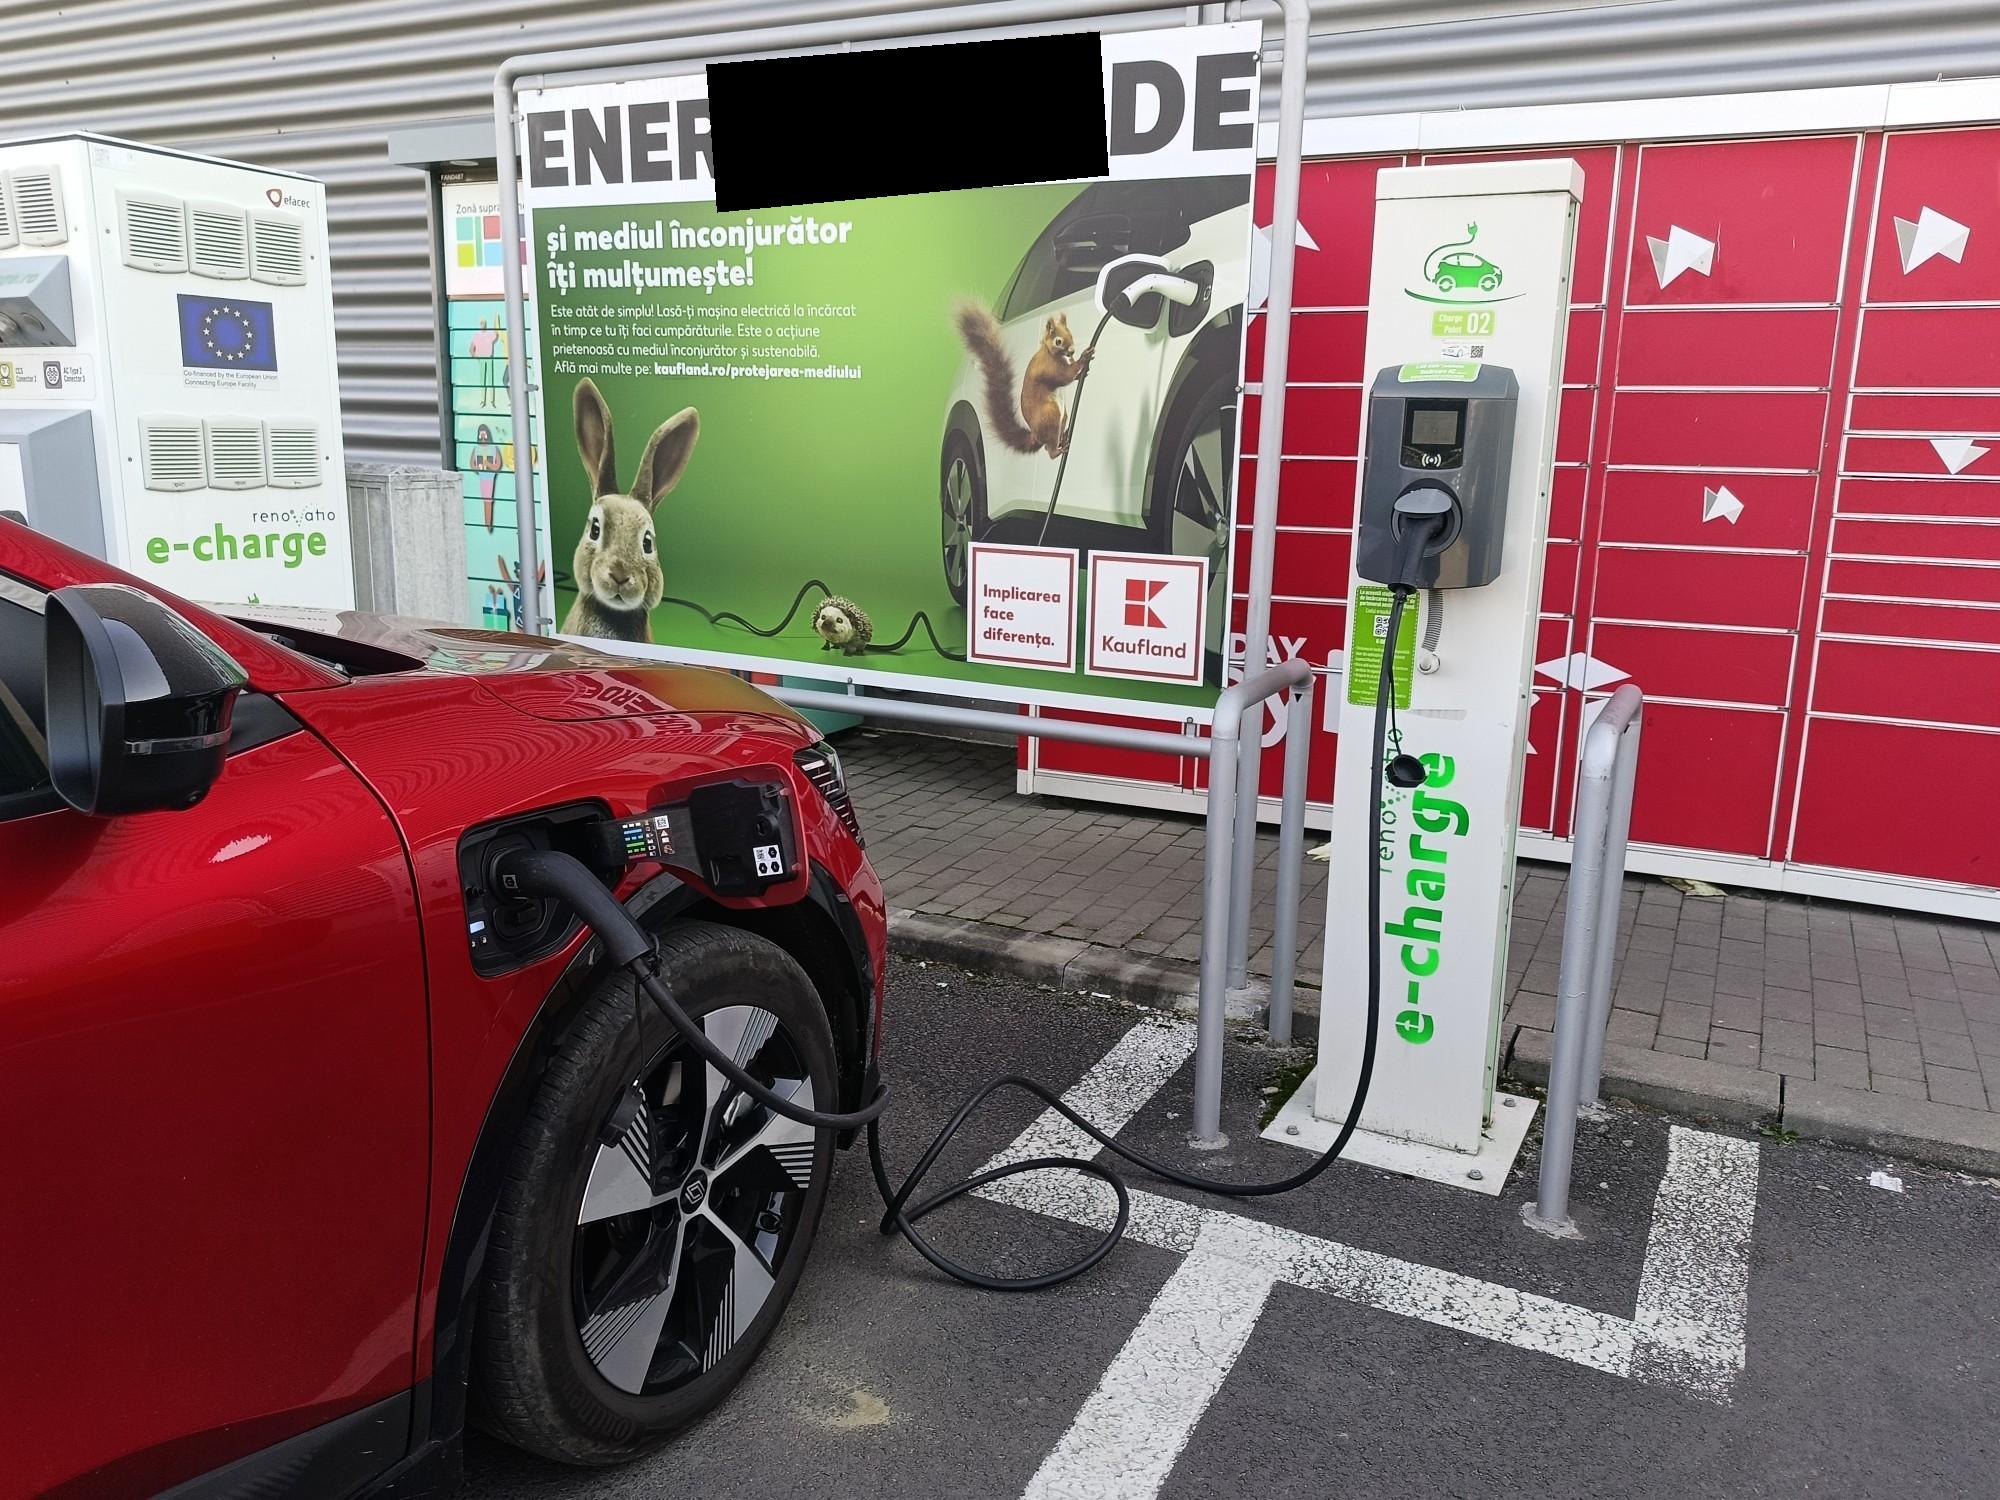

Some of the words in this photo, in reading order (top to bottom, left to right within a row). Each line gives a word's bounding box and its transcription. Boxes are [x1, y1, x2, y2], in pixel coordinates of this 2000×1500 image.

[527, 98, 716, 188] ENER
[284, 195, 311, 208] efacec
[547, 224, 567, 259] și
[574, 220, 663, 250] mediul
[669, 215, 853, 254] înconjurător
[547, 261, 576, 296] îți
[584, 256, 754, 295] mulțumește!
[551, 304, 573, 318] Este
[576, 305, 598, 318] atât
[601, 305, 614, 318] de
[618, 304, 654, 320] simplu!
[656, 304, 694, 320] Lasă-ți
[698, 306, 738, 320] mașina
[740, 304, 790, 317] electrică
[794, 304, 804, 316] la
[808, 304, 856, 316] încărcat
[1440, 314, 1463, 322] Charge
[551, 324, 561, 336] în
[564, 324, 587, 338] timp
[590, 327, 602, 336] ce
[605, 326, 616, 336] tu
[618, 324, 629, 339] îți
[632, 324, 651, 336] faci
[654, 324, 734, 339] cumpărăturile.
[738, 324, 762, 336] Este
[766, 327, 772, 336] o
[776, 325, 820, 340] acțiune
[1466, 312, 1490, 334] 02
[553, 344, 614, 357] prietenoasă
[617, 346, 630, 355] cu
[632, 344, 668, 356] mediul
[670, 344, 737, 359] înconjurător
[740, 344, 749, 360] și
[752, 344, 820, 358] sustenabilă.
[218, 372, 224, 380] by
[554, 361, 576, 374] Află
[578, 362, 598, 374] mai
[601, 362, 632, 374] multe
[635, 364, 652, 376] pe:
[654, 362, 862, 380] kaufland.ro/protejarea-mediului
[184, 379, 216, 387] Connecting
[217, 380, 236, 388] Europe
[146, 523, 326, 568] e-charge
[984, 584, 1061, 604] Implicarea
[984, 606, 1014, 621] face
[983, 627, 1055, 648] diferența.
[1102, 636, 1186, 660] Kaufland
[1385, 752, 1470, 1045] e-charge
